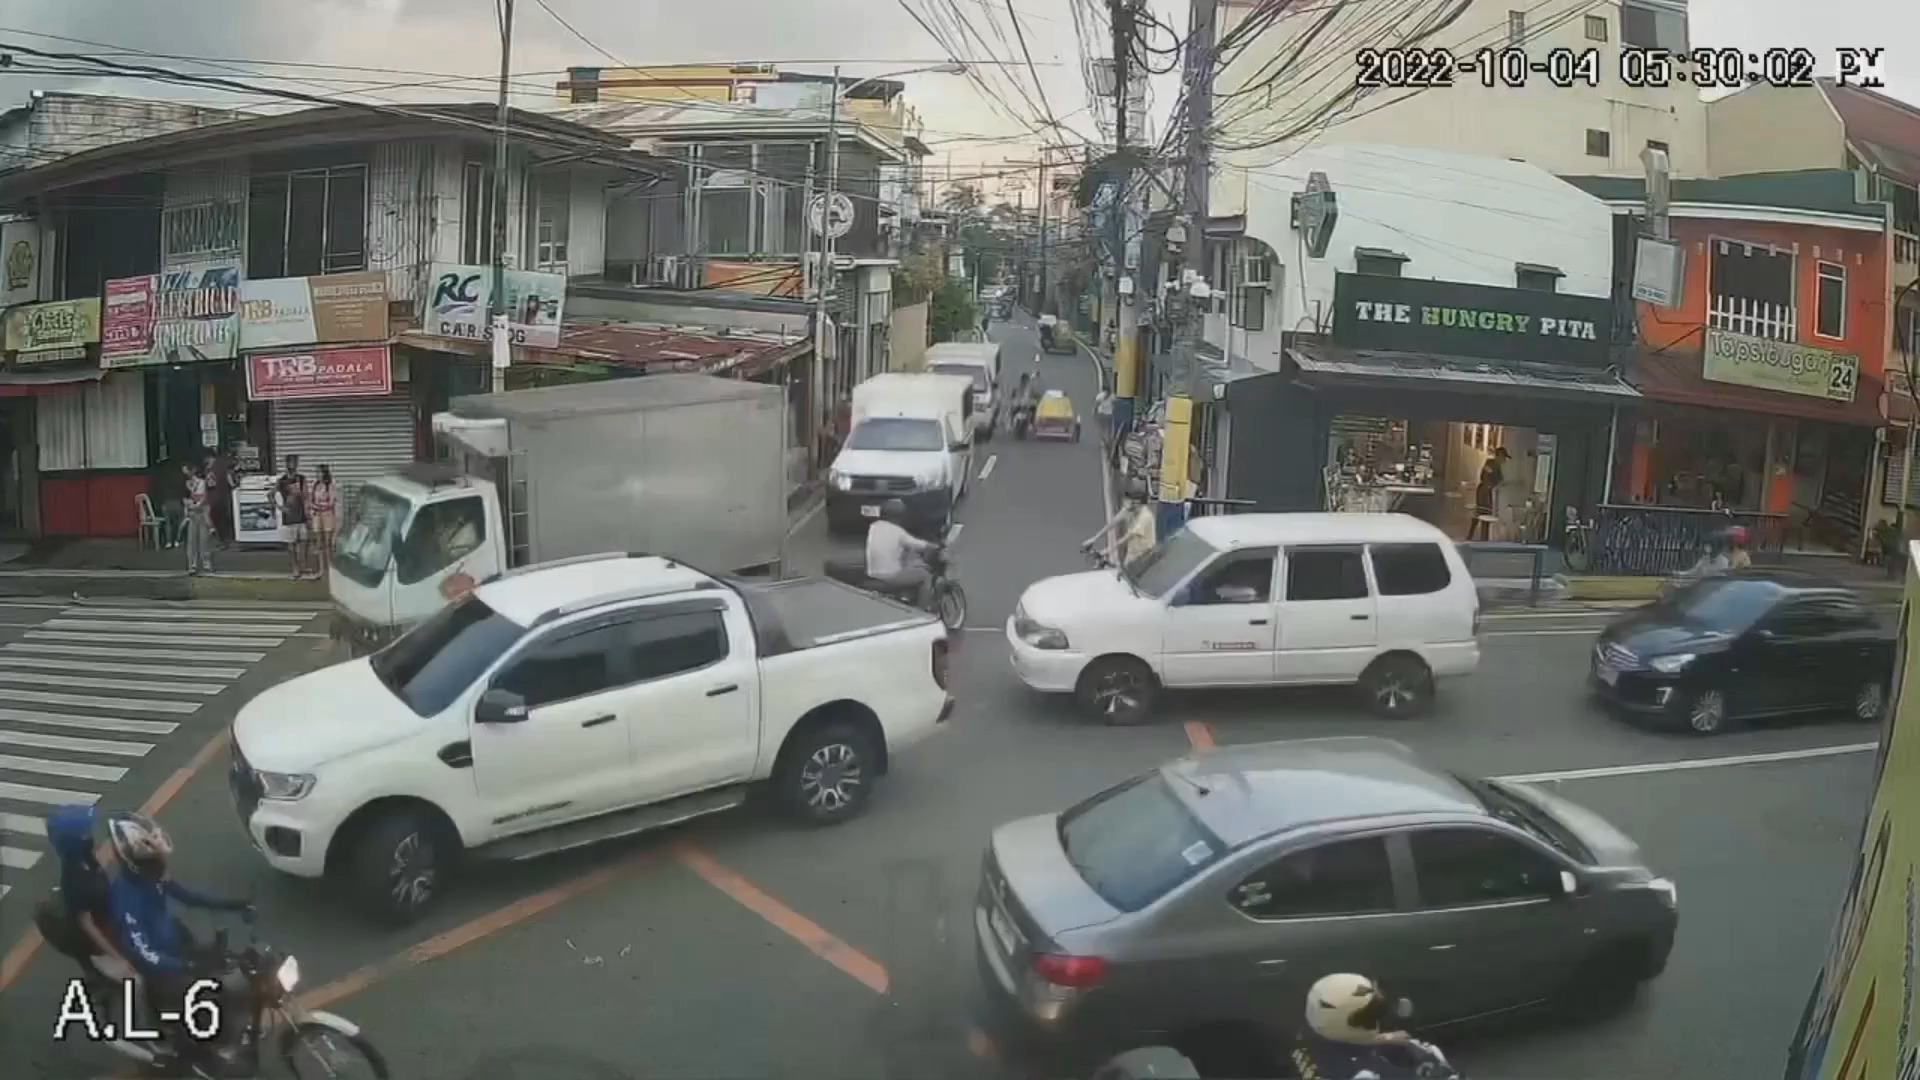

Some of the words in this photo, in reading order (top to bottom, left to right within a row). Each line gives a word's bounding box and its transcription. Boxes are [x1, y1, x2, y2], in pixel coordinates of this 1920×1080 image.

[432, 273, 480, 308] RC
[440, 321, 476, 338] CAR
[1356, 301, 1411, 324] THE
[1422, 305, 1531, 333] HUNGRY
[1540, 317, 1597, 341] PITA
[260, 355, 317, 378] TRB
[317, 362, 373, 375] PADALA
[1831, 365, 1853, 391] 24
